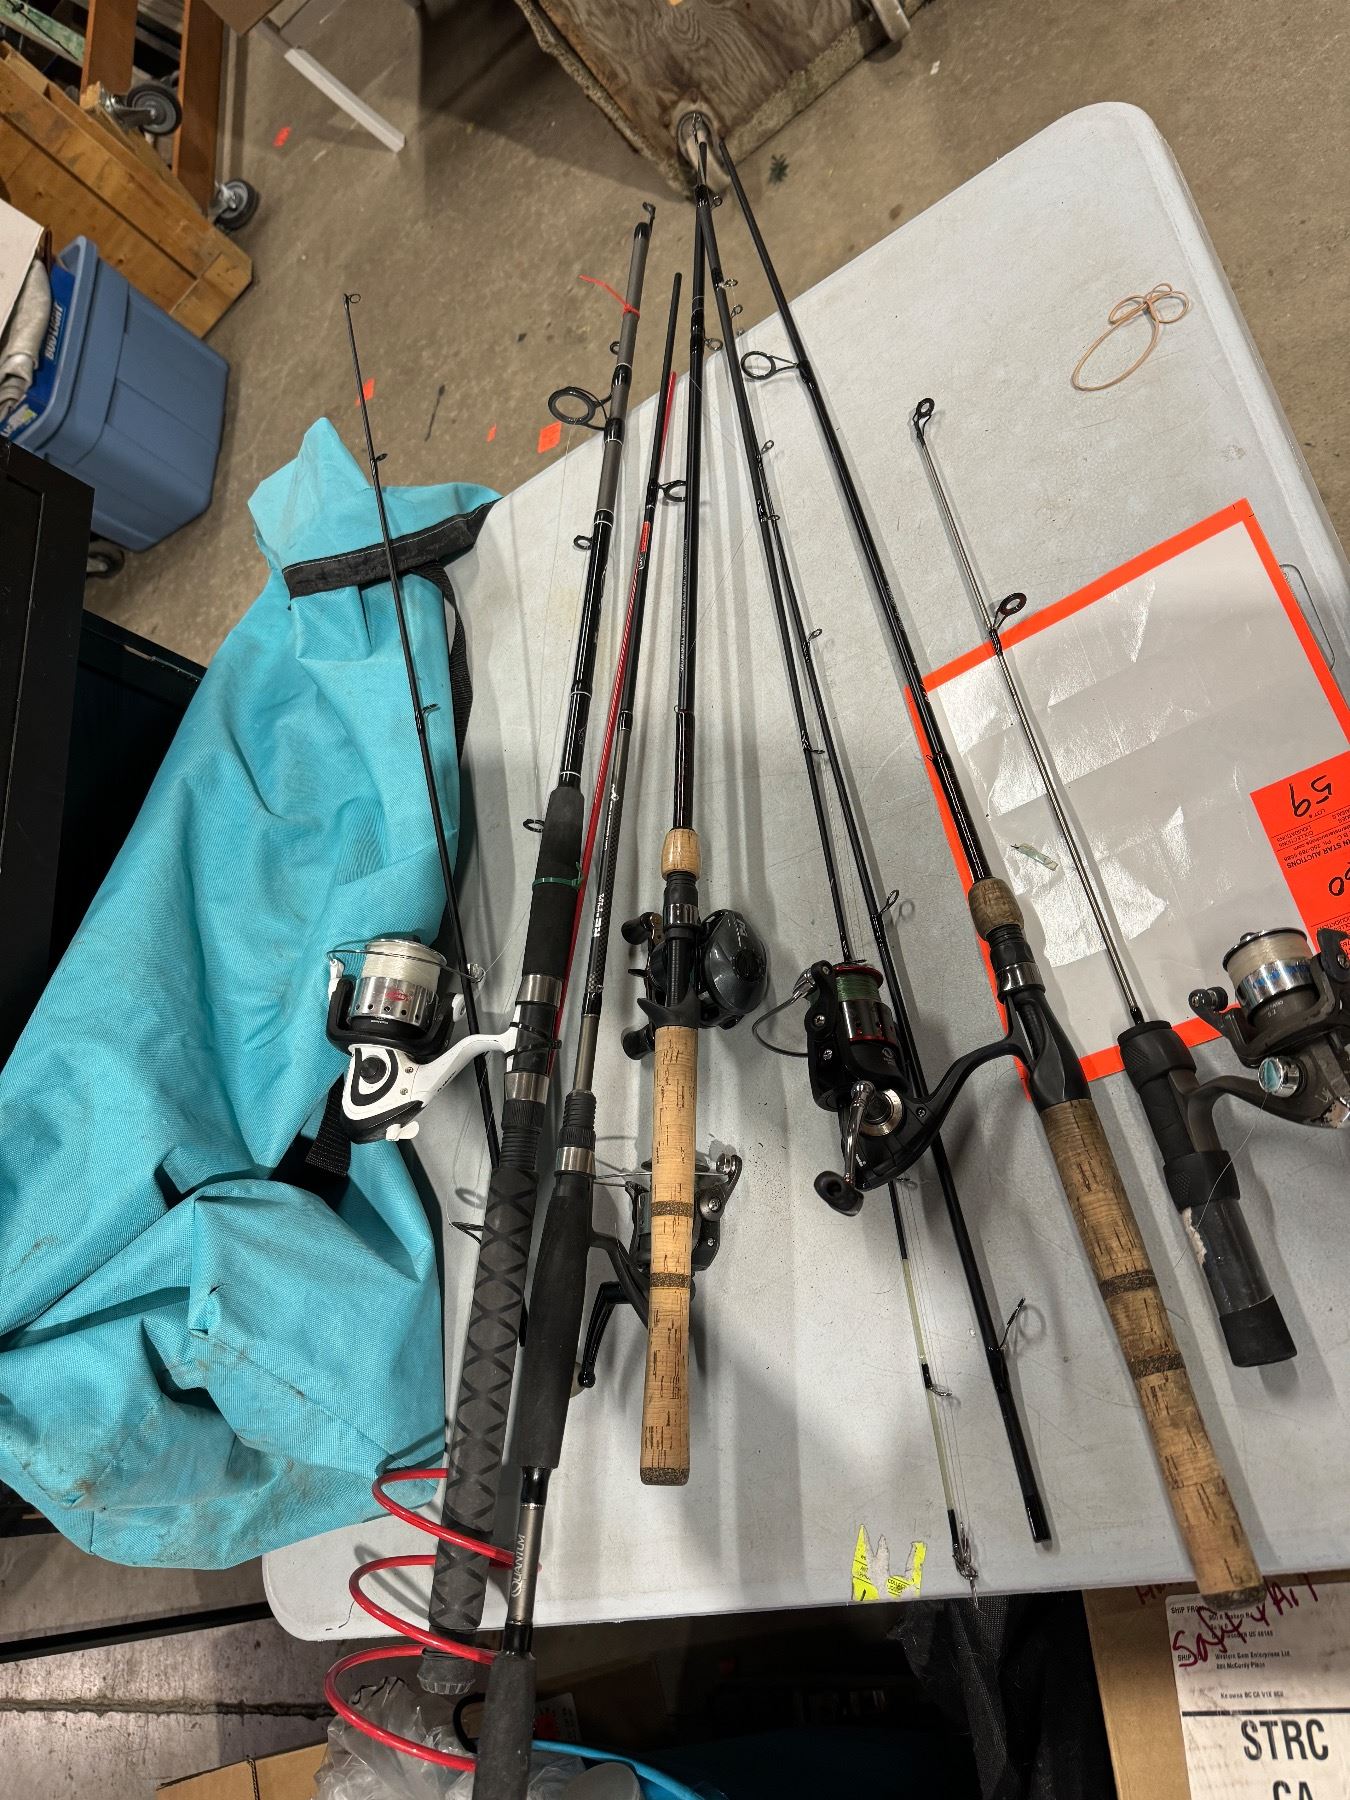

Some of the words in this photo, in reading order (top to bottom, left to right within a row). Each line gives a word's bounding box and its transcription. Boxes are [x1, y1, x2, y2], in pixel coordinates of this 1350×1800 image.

[1289, 775, 1333, 818] 59
[1323, 842, 1342, 855] STAR
[1286, 850, 1321, 869] AUCTIONS
[512, 1534, 525, 1597] QUANTUM
[1171, 1606, 1185, 1614] SHIP
[1177, 1654, 1192, 1662] SHIP
[1240, 1718, 1329, 1761] STRC
